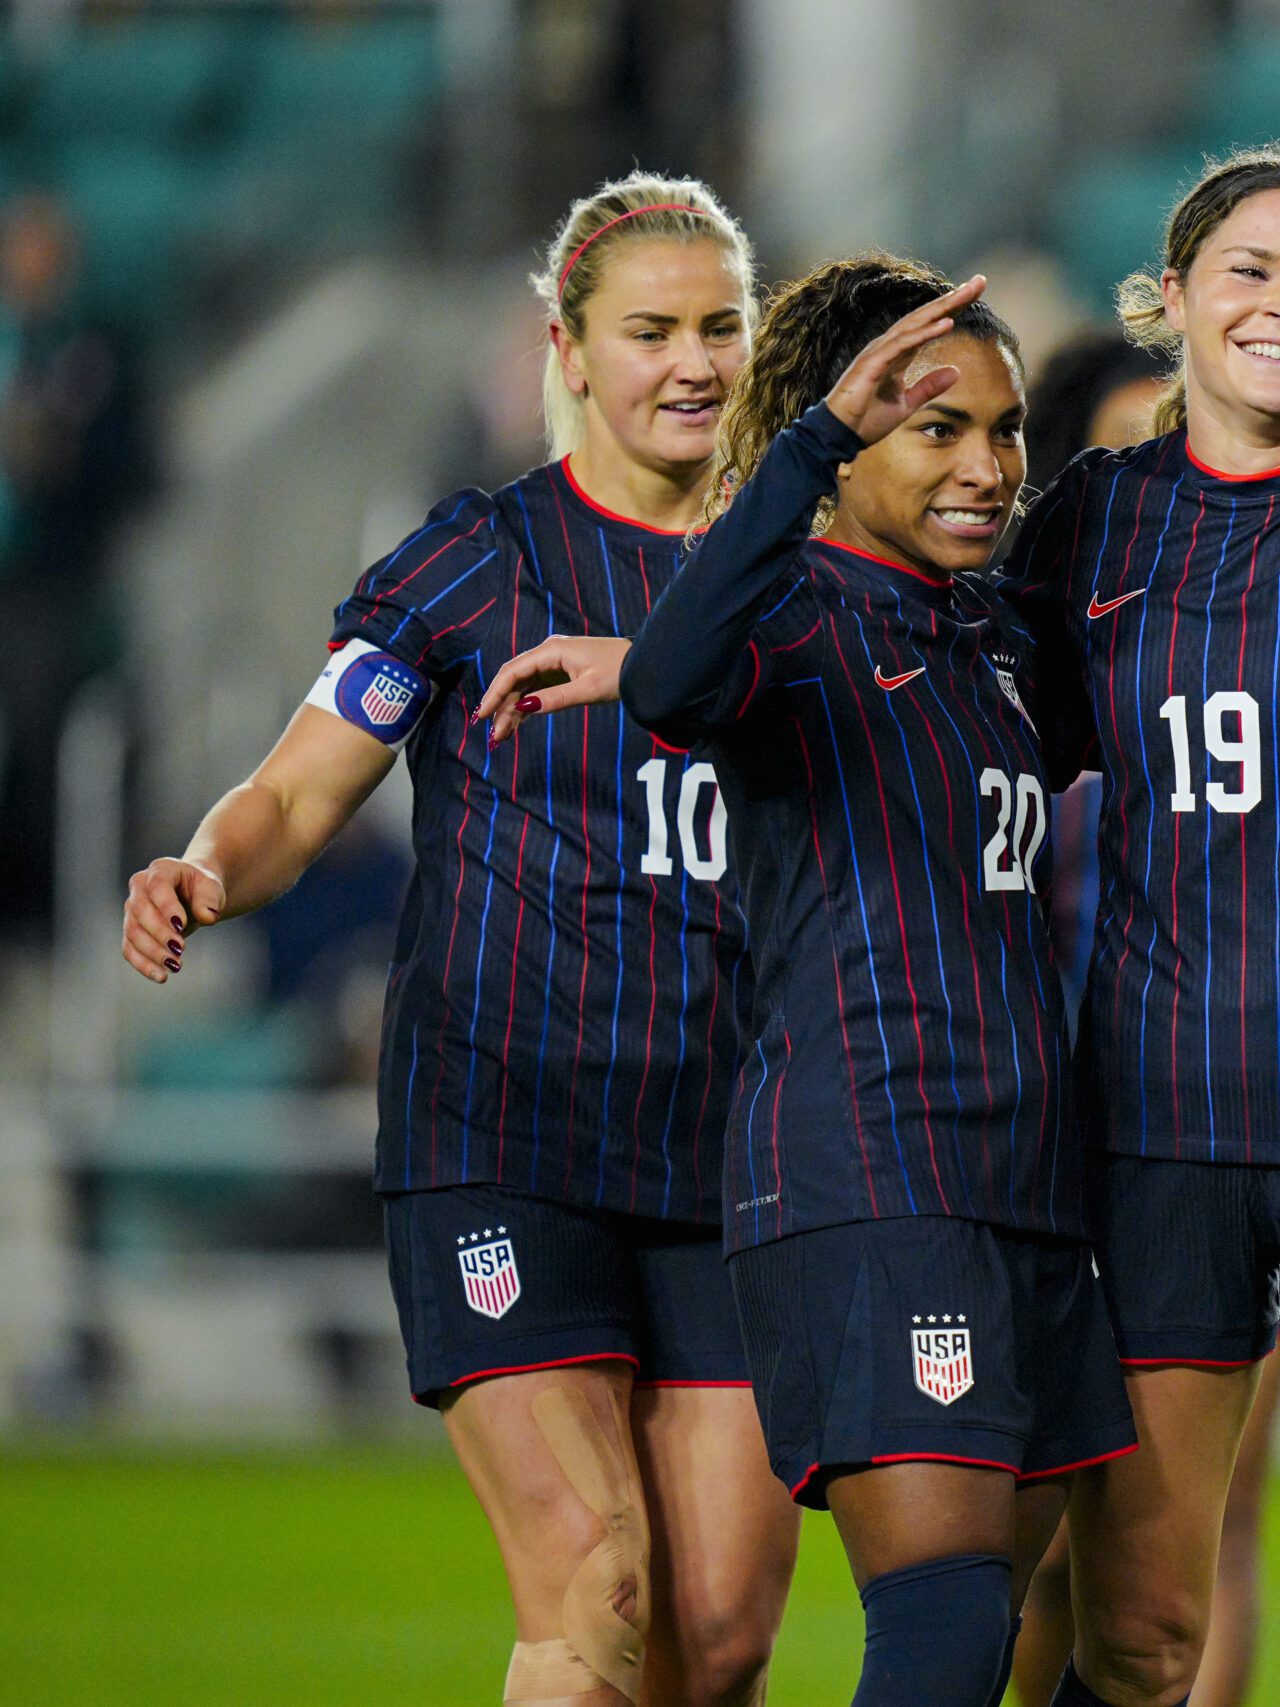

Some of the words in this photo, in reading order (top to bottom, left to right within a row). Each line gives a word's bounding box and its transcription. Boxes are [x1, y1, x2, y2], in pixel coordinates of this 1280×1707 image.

[374, 675, 411, 705] USA
[1159, 691, 1262, 813] 19
[636, 758, 728, 882] 10
[979, 767, 1047, 895] 20
[462, 1244, 511, 1277] USA
[916, 1333, 966, 1361] USA
